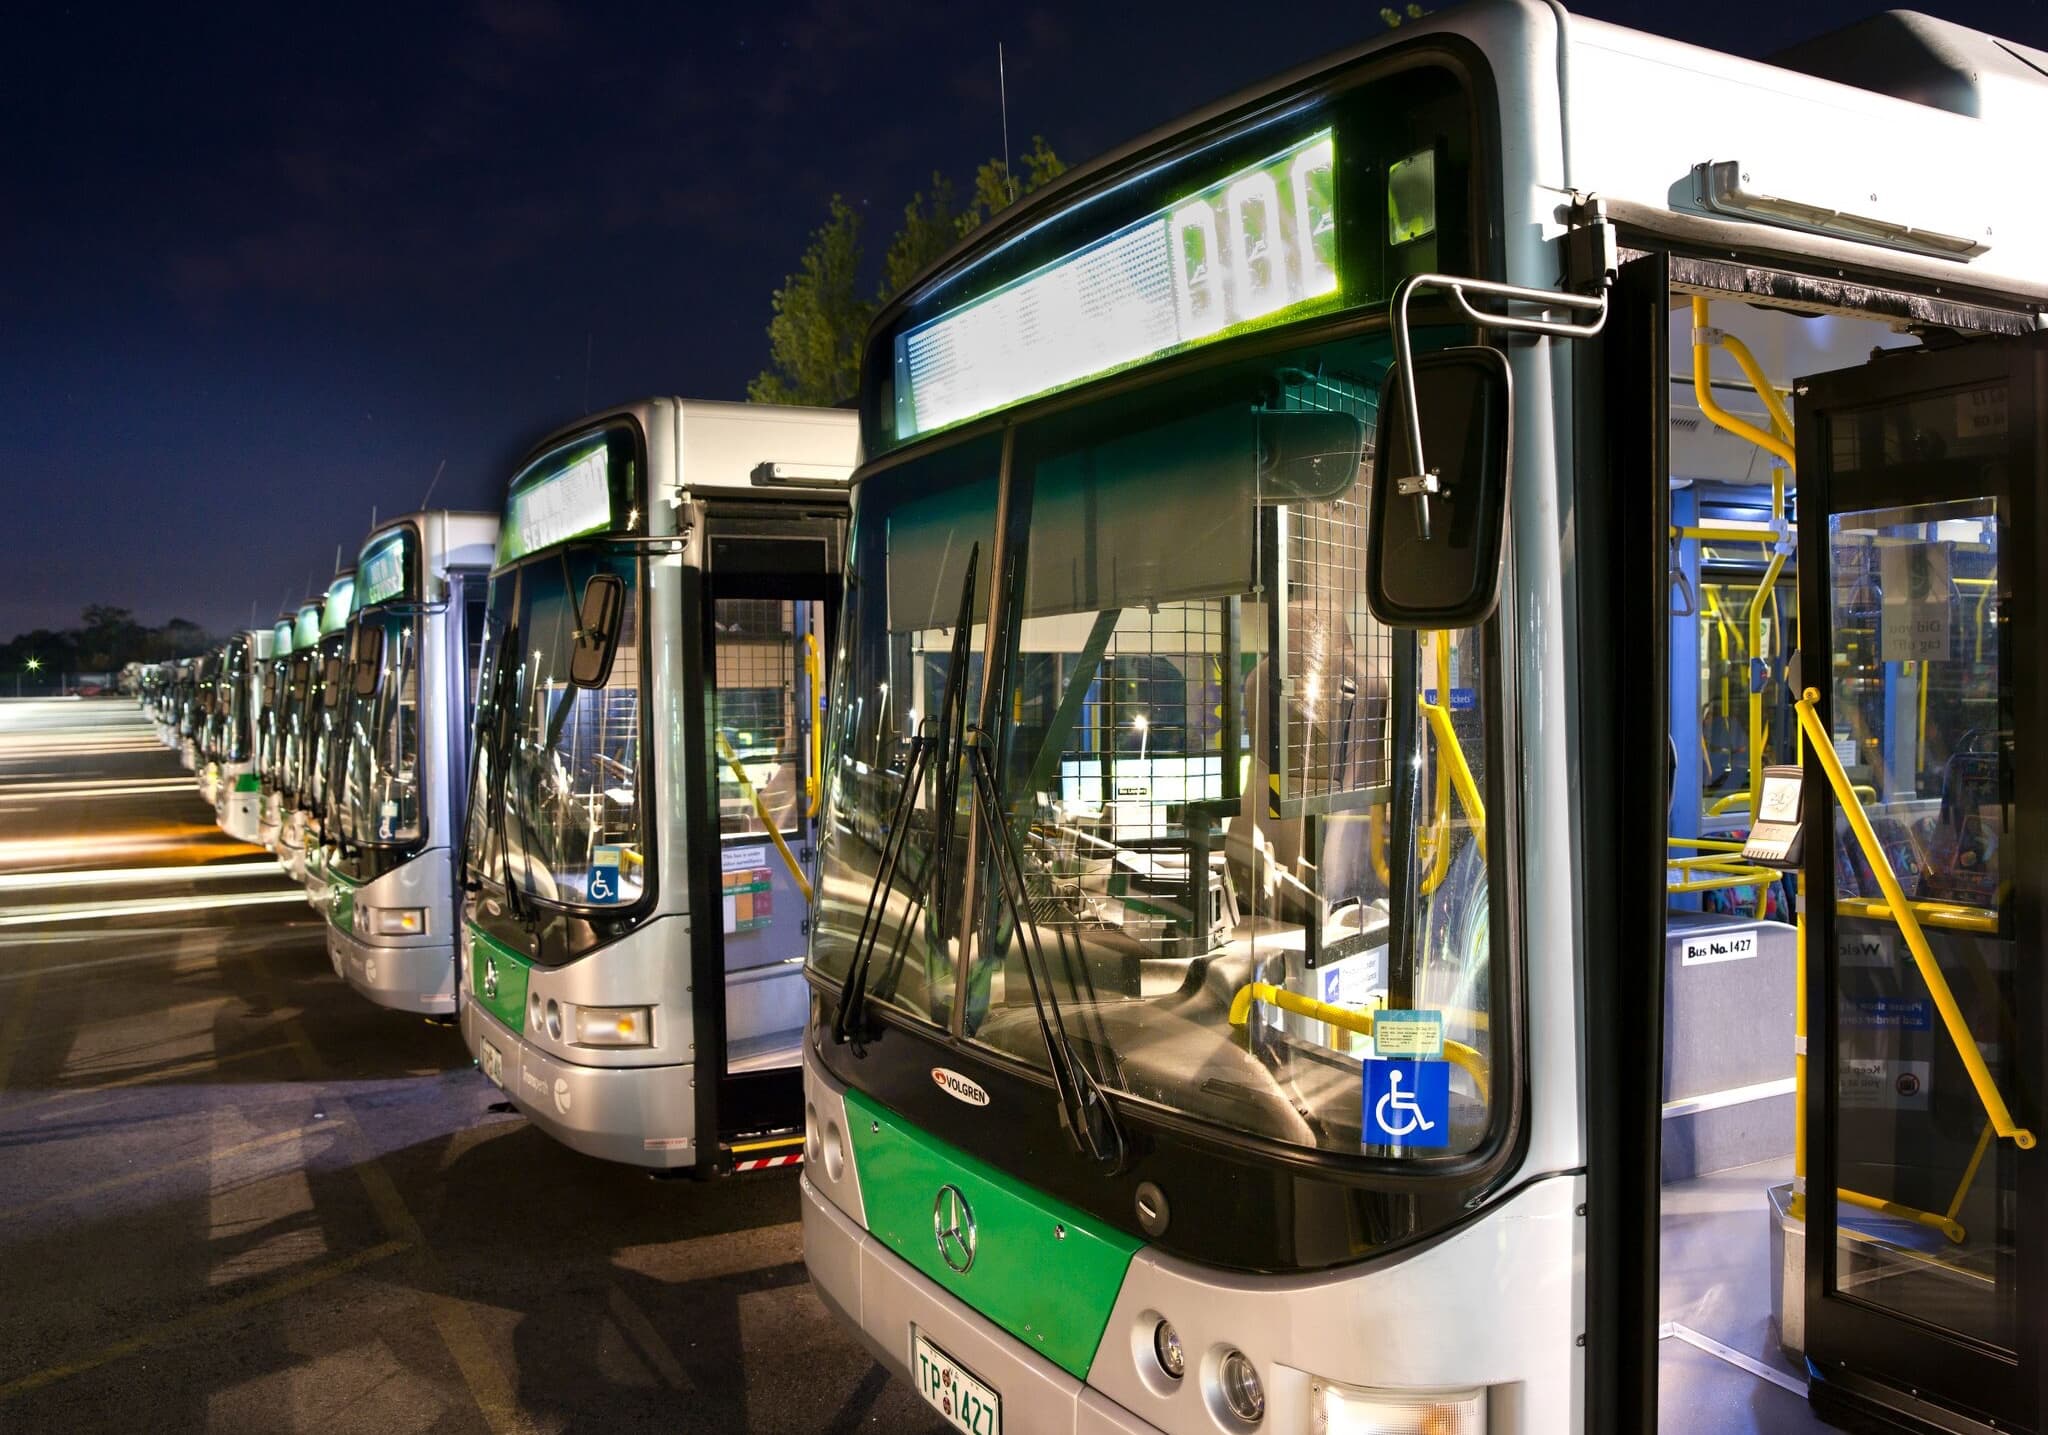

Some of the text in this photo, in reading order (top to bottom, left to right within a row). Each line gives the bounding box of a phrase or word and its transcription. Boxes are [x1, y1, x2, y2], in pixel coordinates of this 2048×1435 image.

[1687, 939, 1751, 959] Bus No. 1427
[946, 1074, 986, 1104] VOLGREN
[920, 1353, 993, 1435] TP 1427
